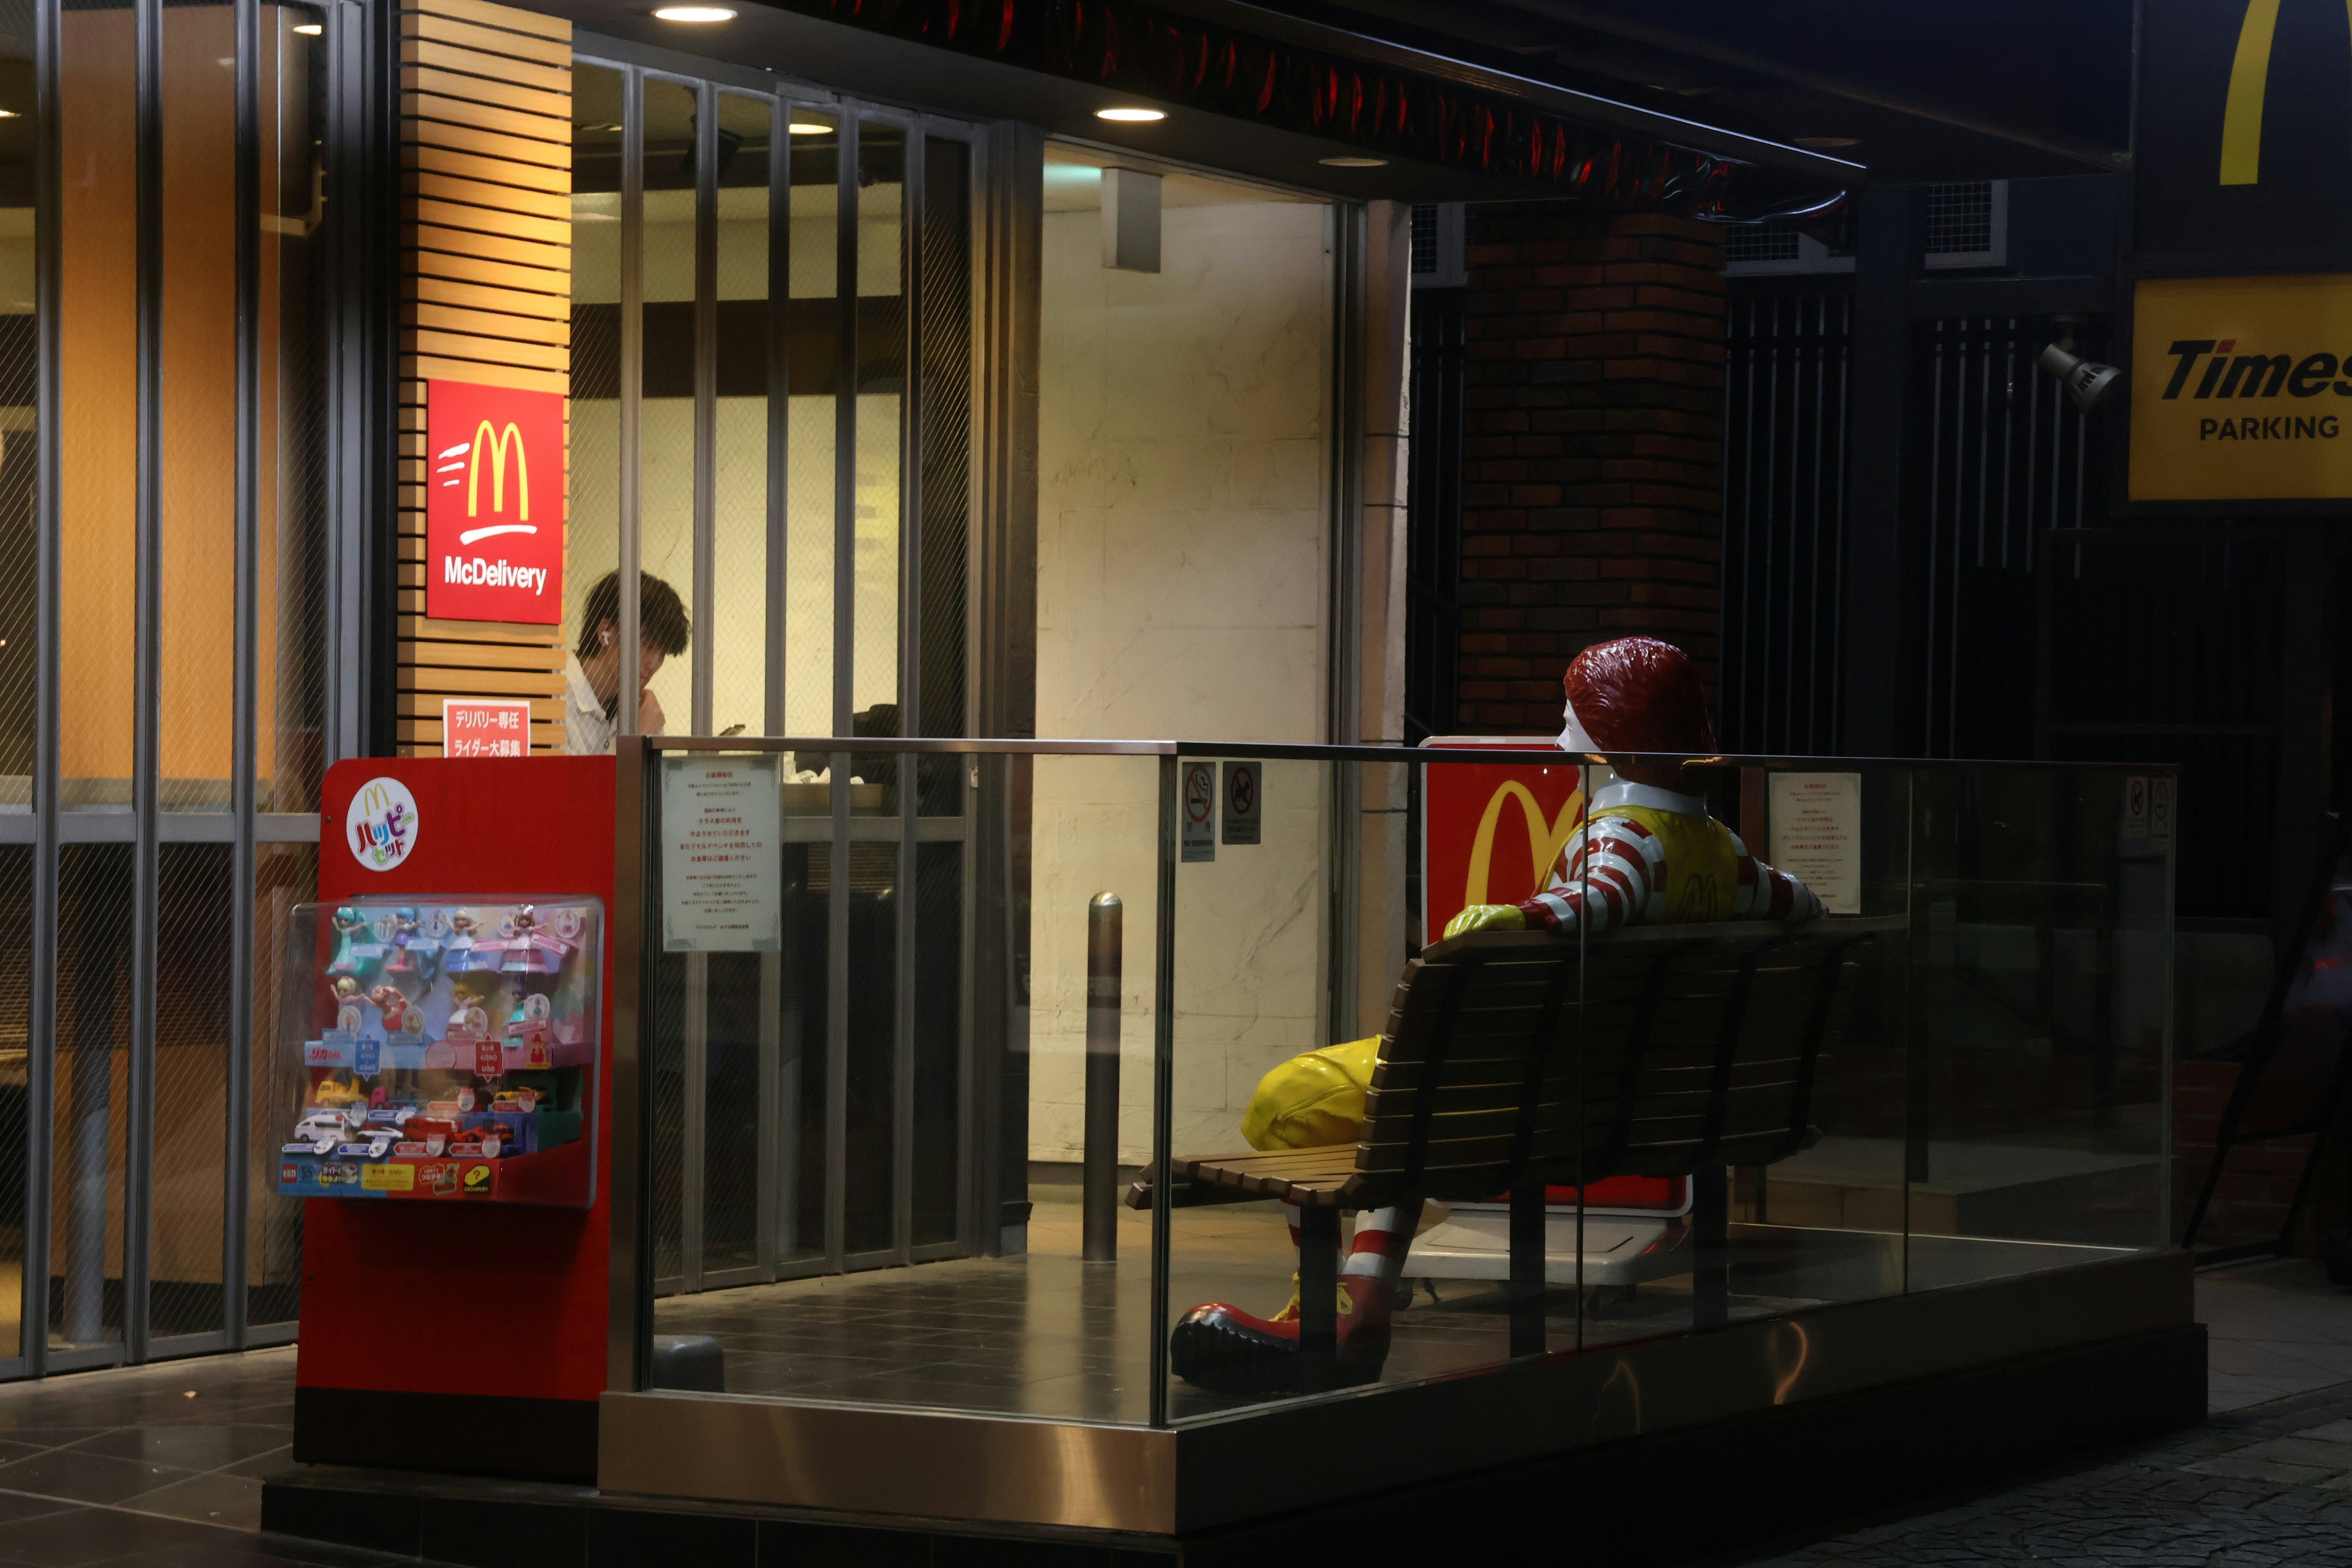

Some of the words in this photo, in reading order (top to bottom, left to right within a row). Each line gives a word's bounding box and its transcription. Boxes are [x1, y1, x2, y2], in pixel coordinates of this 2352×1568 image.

[2200, 415, 2339, 441] PARKING
[445, 555, 547, 596] McDelivery
[456, 710, 519, 730] デリバリー専任
[454, 738, 521, 757] ライダー大募集
[356, 804, 414, 853] ハッピー
[373, 839, 404, 864] セット
